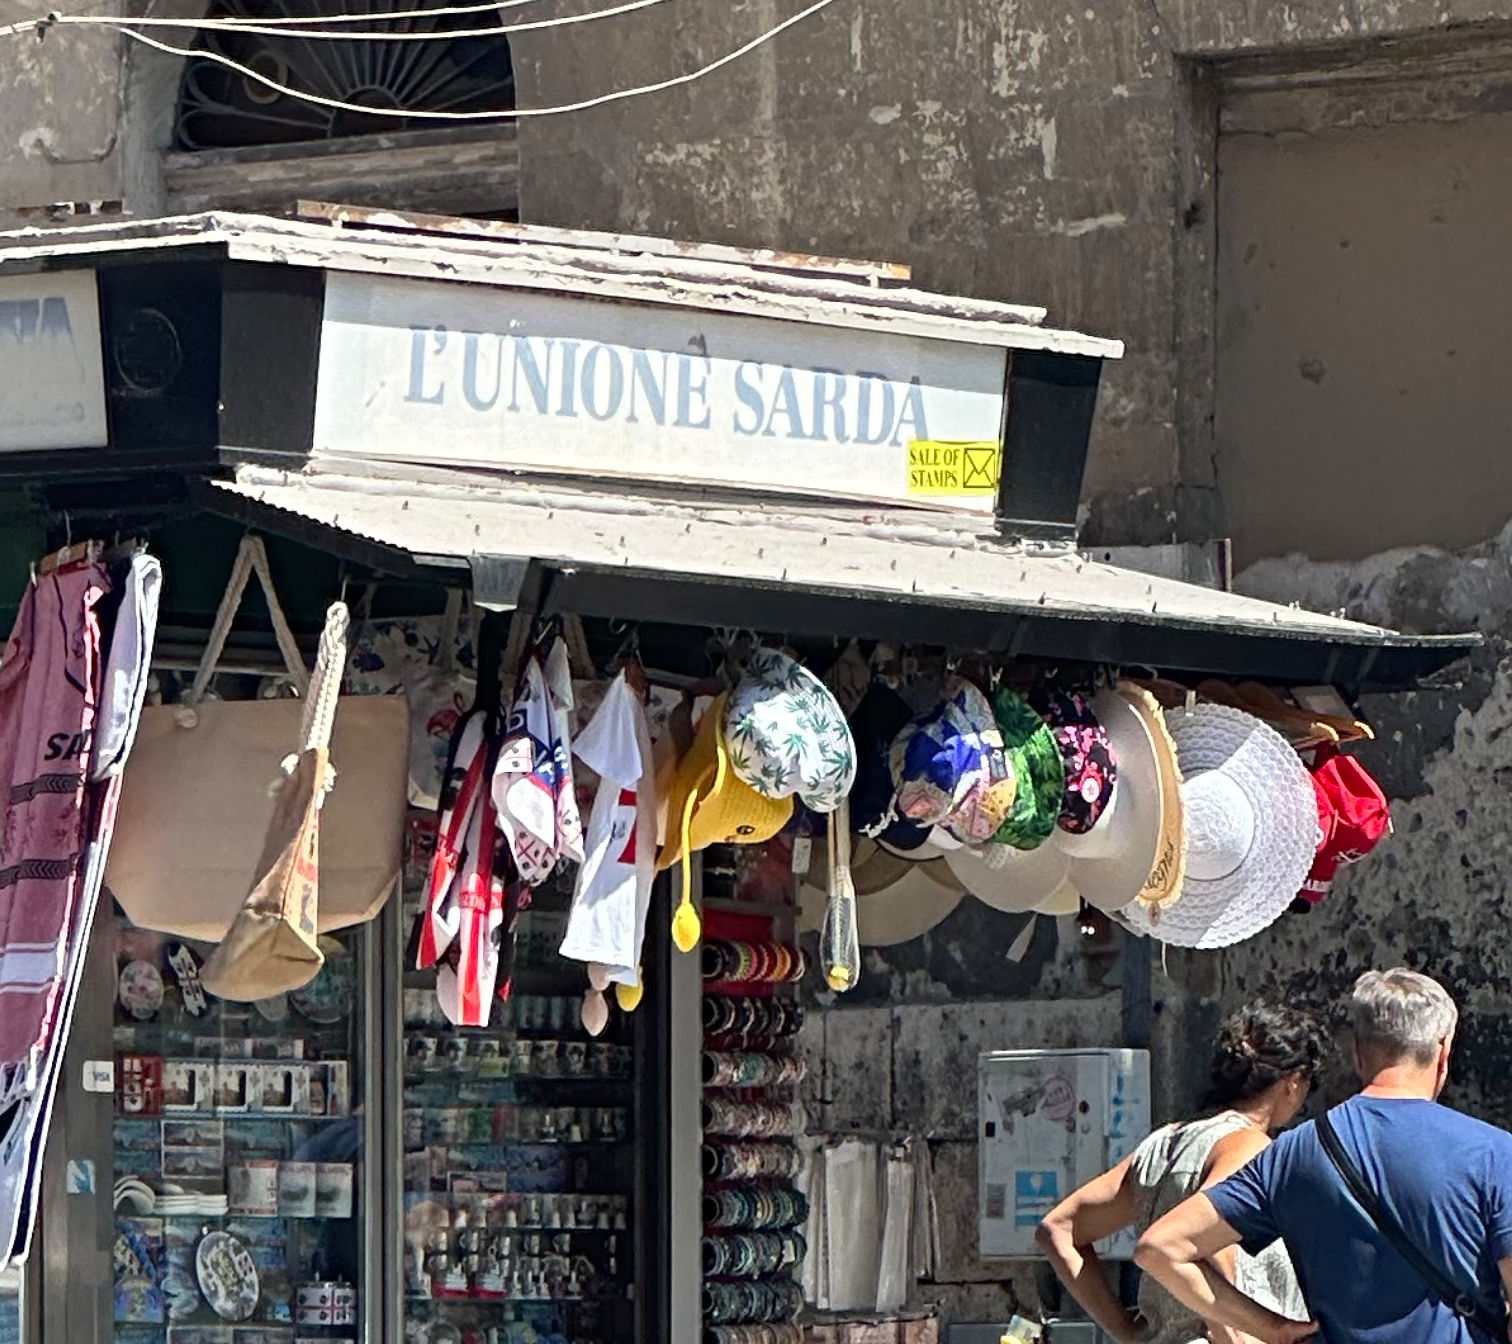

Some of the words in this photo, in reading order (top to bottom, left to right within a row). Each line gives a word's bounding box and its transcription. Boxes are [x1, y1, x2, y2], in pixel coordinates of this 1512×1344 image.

[403, 323, 713, 431] L'UNIONE
[731, 358, 931, 447] SARDA
[909, 448, 940, 466] SALE
[943, 448, 960, 466] OF
[910, 469, 958, 488] STAMPS
